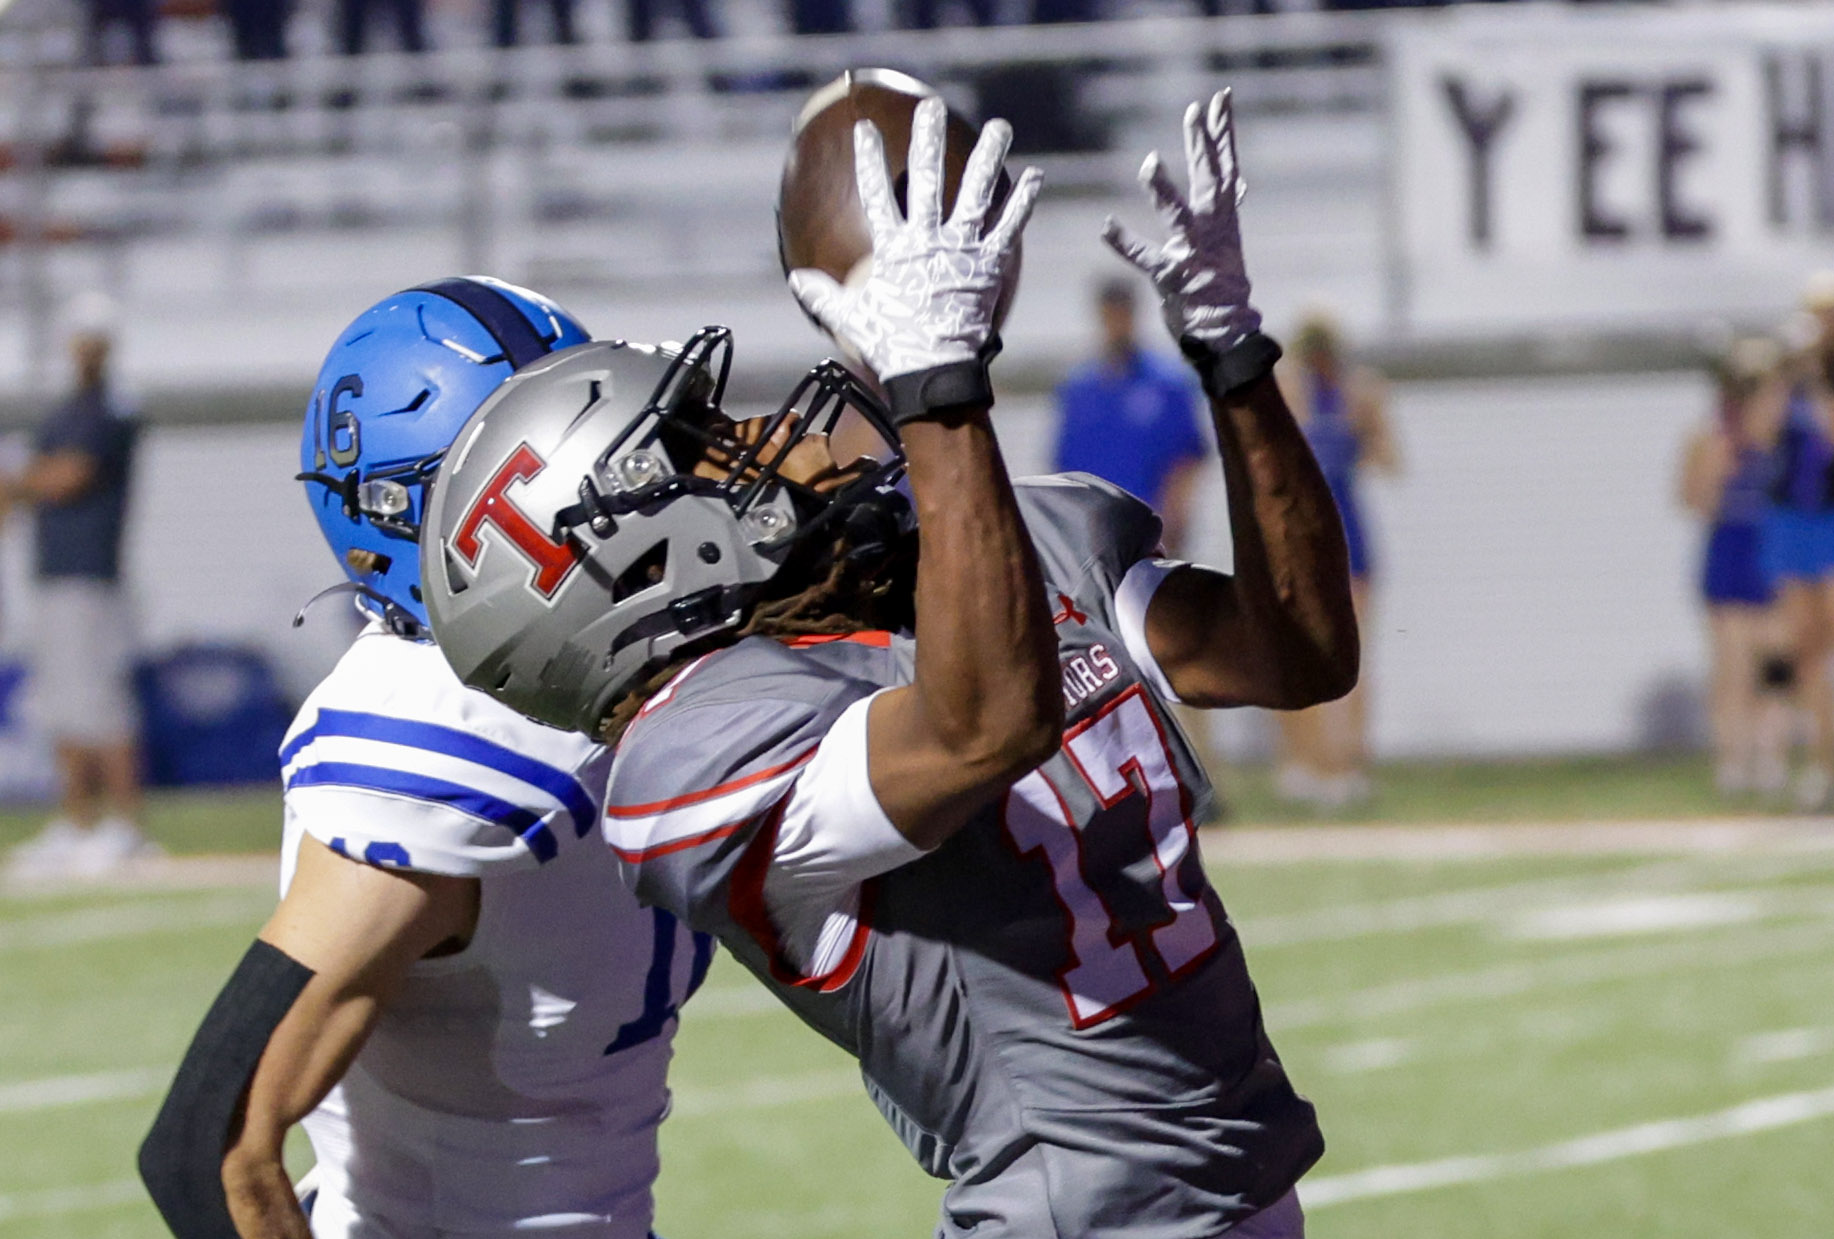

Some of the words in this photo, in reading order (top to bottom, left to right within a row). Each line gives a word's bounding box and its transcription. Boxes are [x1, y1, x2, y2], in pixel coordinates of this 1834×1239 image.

[314, 373, 364, 470] 16
[449, 440, 598, 608] T
[1005, 682, 1219, 1029] 17
